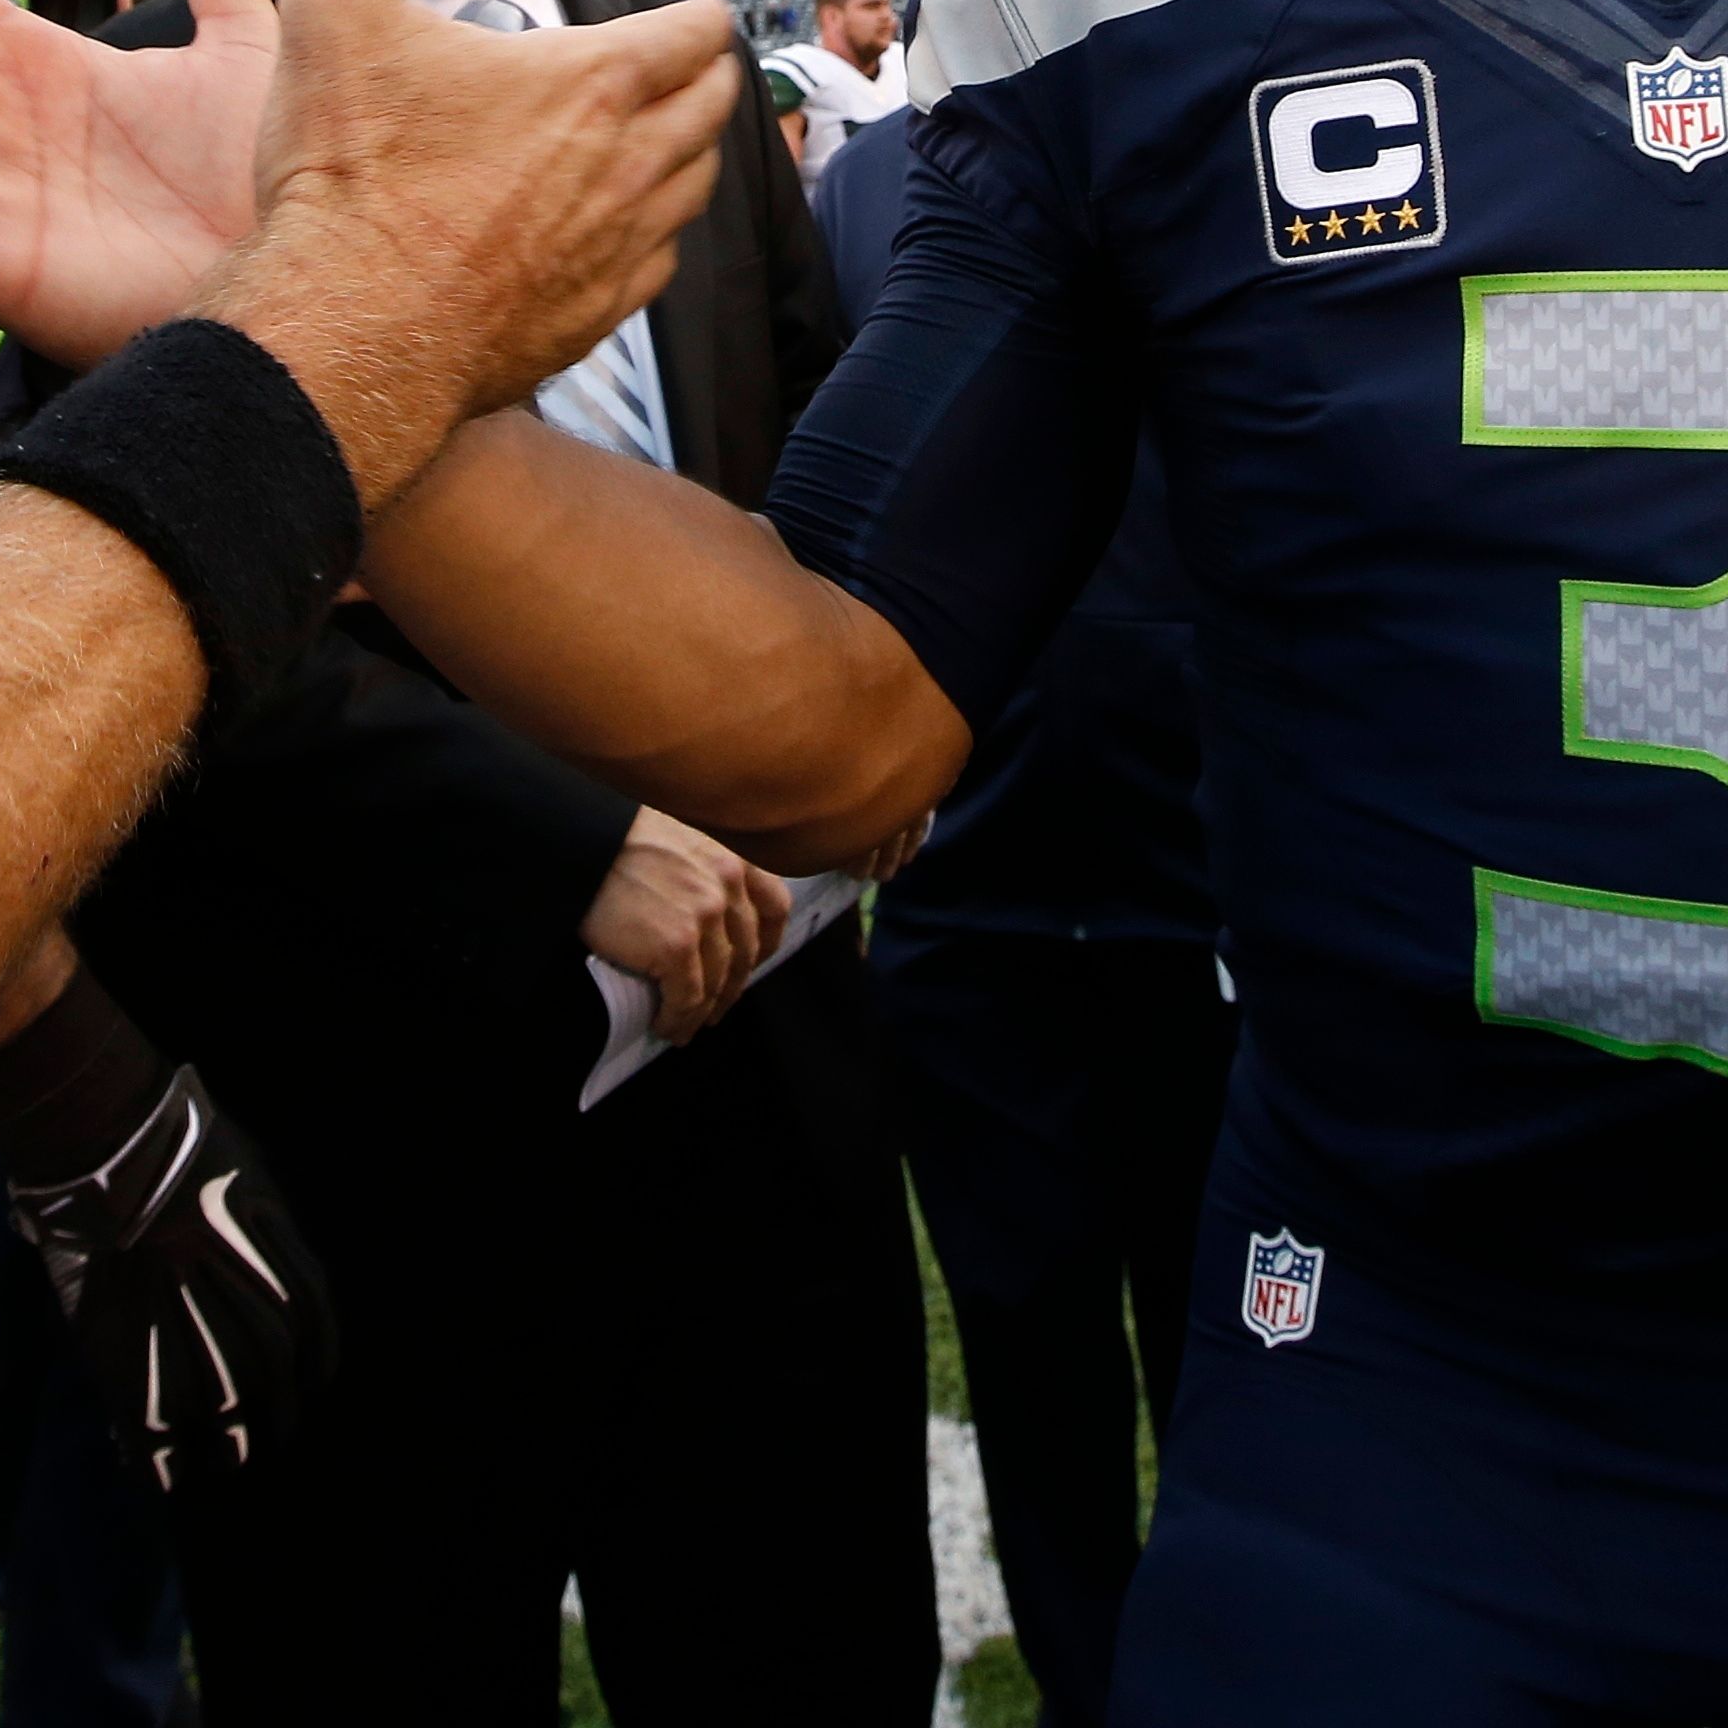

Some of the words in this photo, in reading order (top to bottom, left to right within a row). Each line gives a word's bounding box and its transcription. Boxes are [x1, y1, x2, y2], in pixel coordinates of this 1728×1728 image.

[1268, 77, 1423, 210] C
[1648, 102, 1721, 150] NFL
[1253, 1278, 1303, 1327] NFL
